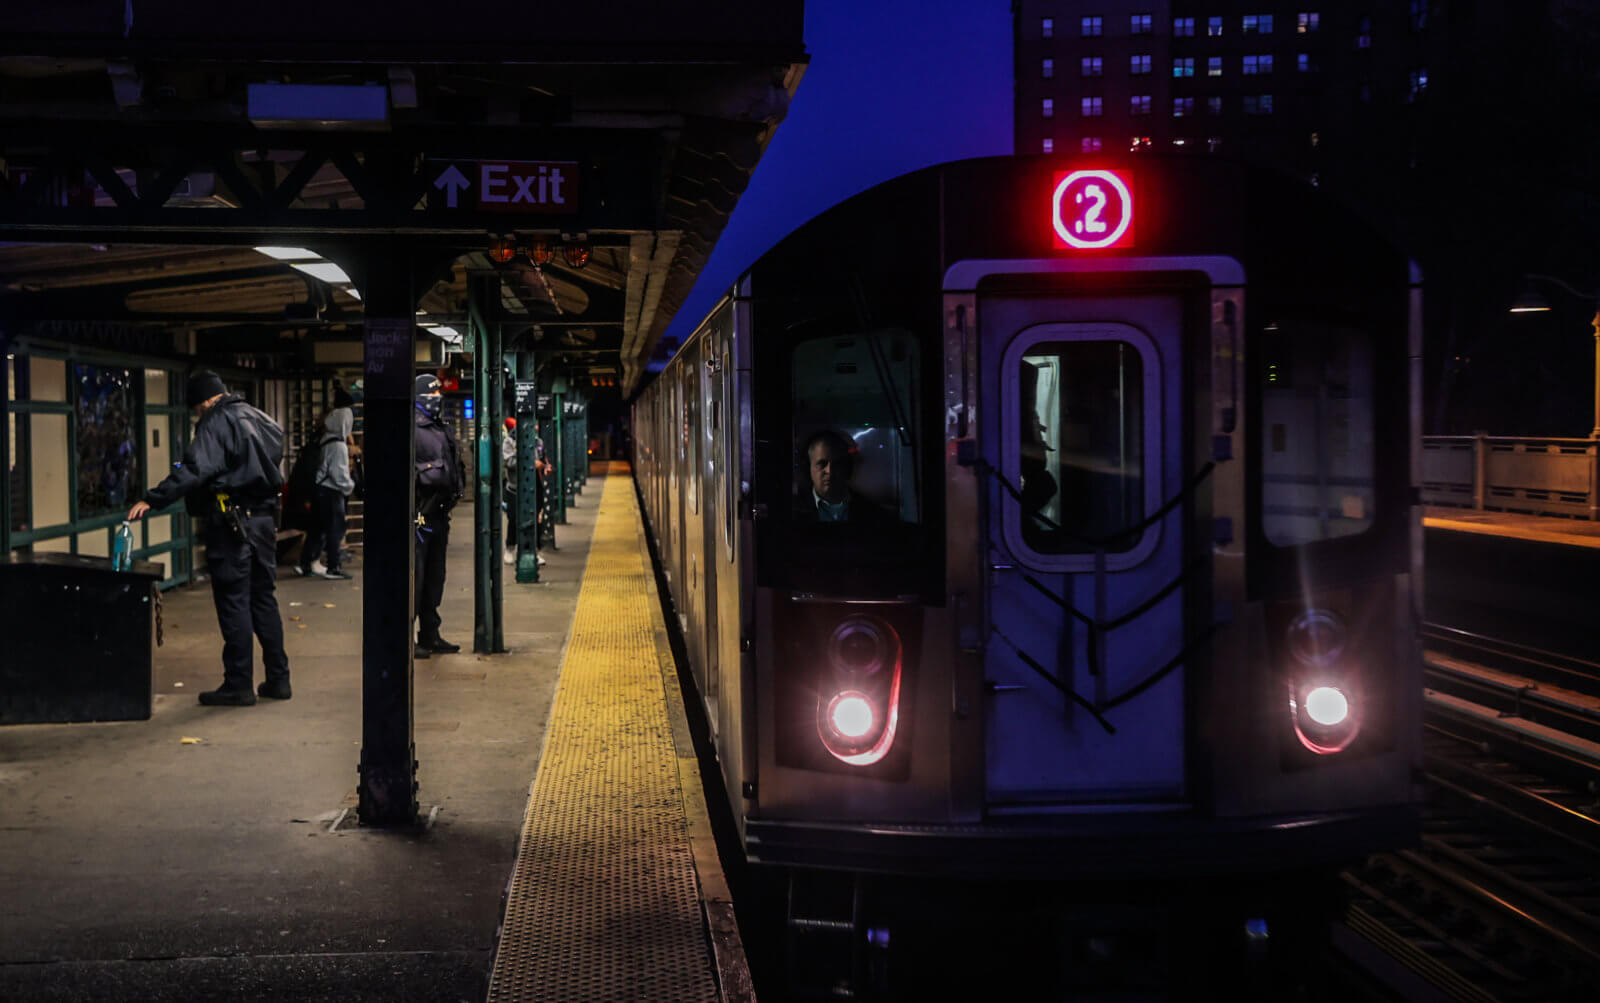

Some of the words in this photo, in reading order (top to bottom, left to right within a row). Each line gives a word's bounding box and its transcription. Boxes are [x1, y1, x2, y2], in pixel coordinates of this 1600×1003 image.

[480, 164, 565, 204] Exit
[1083, 184, 1107, 233] 2
[367, 360, 385, 373] Av
